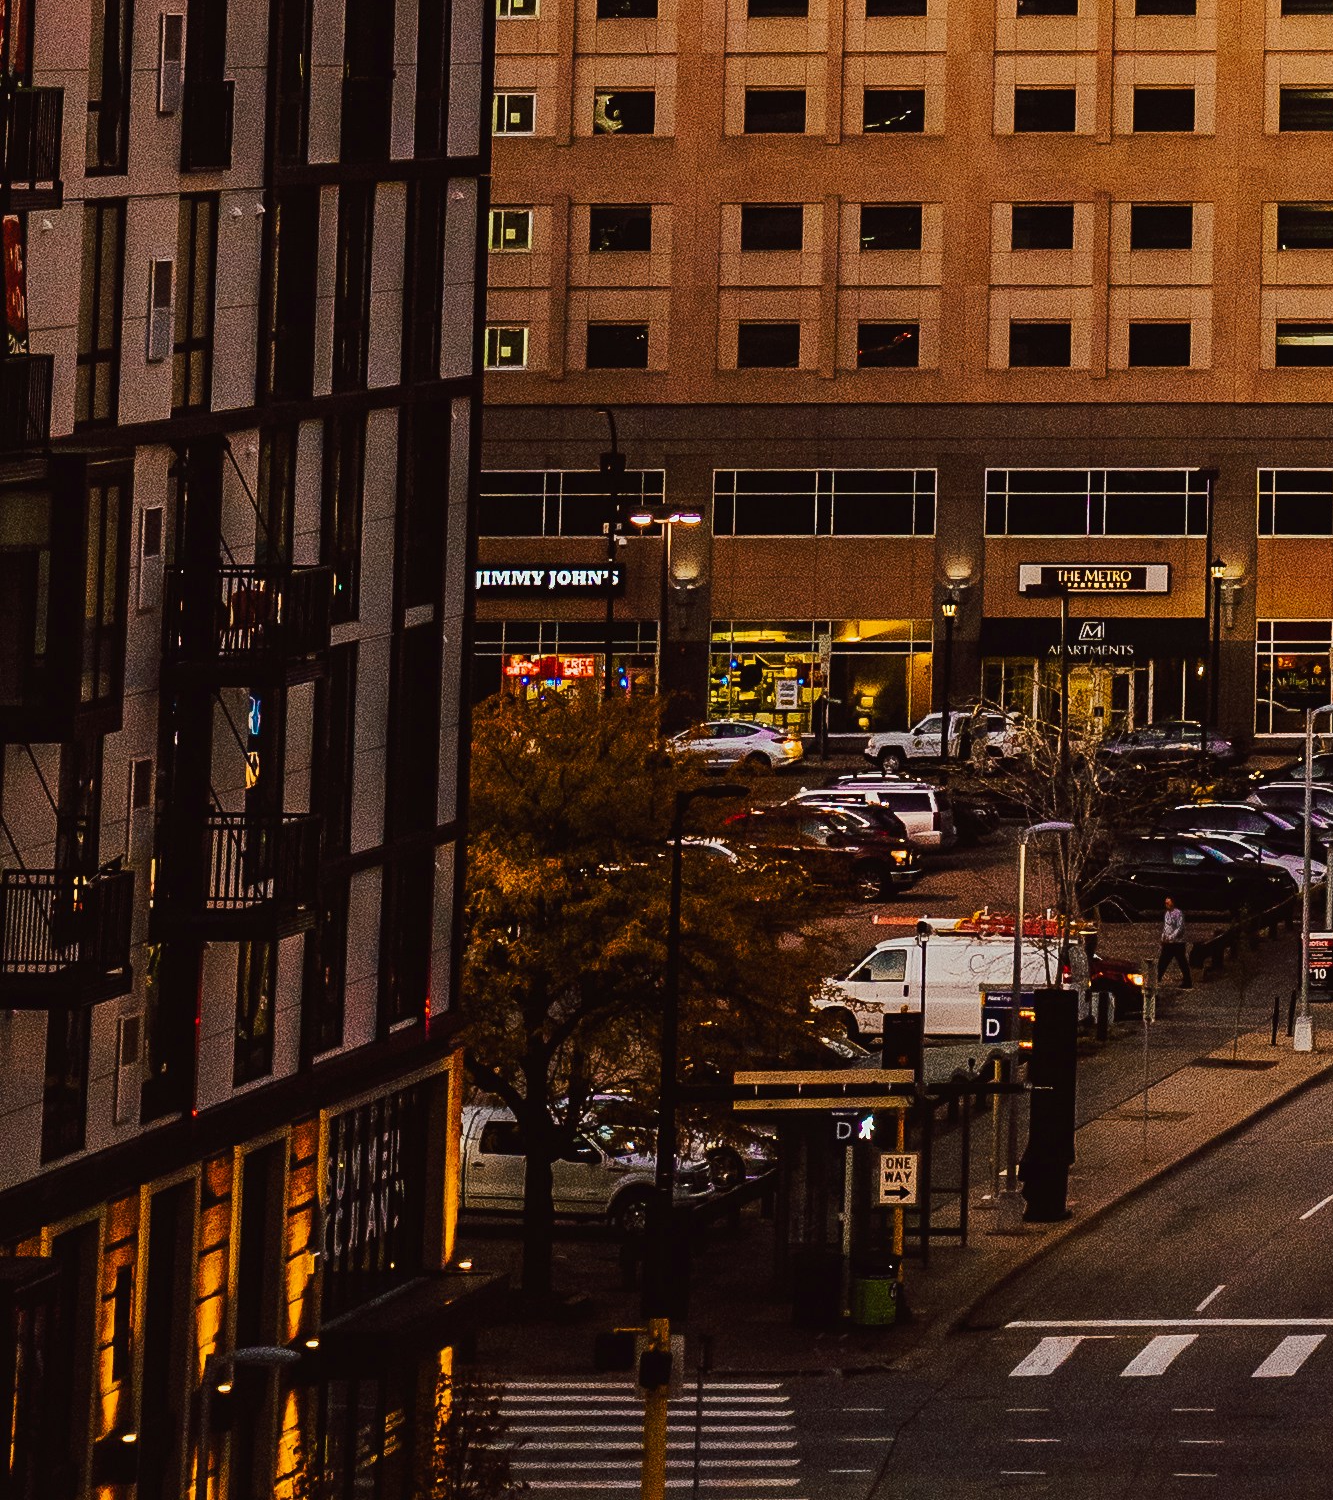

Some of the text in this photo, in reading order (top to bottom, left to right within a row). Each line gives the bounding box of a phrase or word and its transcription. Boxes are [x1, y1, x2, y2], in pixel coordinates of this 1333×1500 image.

[475, 570, 619, 589] JIMMY JOHN'S
[1057, 569, 1132, 581] THE METRO
[986, 1018, 1000, 1037] D
[837, 1121, 852, 1140] D
[885, 1157, 912, 1170] ONE
[884, 1171, 913, 1183] WAY
